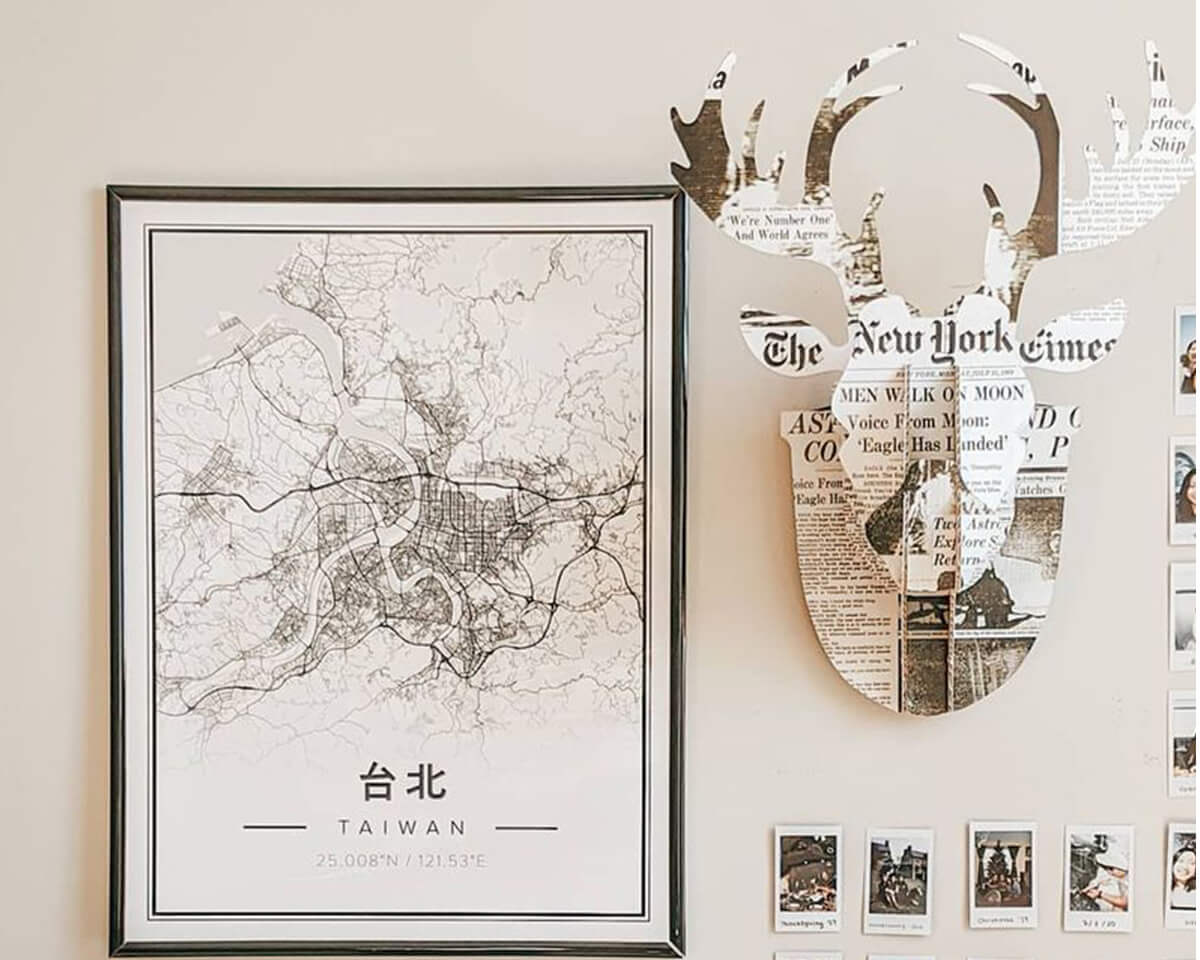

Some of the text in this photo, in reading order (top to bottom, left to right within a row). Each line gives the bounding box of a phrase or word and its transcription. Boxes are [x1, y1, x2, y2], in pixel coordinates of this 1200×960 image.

[1150, 137, 1187, 154] Ship
[764, 213, 806, 225] Number
[758, 229, 790, 240] World
[795, 229, 829, 241] Agrees
[764, 331, 823, 372] The
[851, 318, 923, 358] New
[929, 316, 1014, 366] York
[840, 386, 878, 403] MEN
[976, 384, 1025, 400] MOON
[847, 413, 888, 431] Voice
[895, 412, 936, 430] From
[911, 436, 941, 452] Has
[1016, 483, 1053, 496] atches
[933, 534, 986, 551] Expore
[933, 552, 980, 566] Retrn
[359, 760, 447, 802] 台北
[338, 818, 466, 837] TAIWAN
